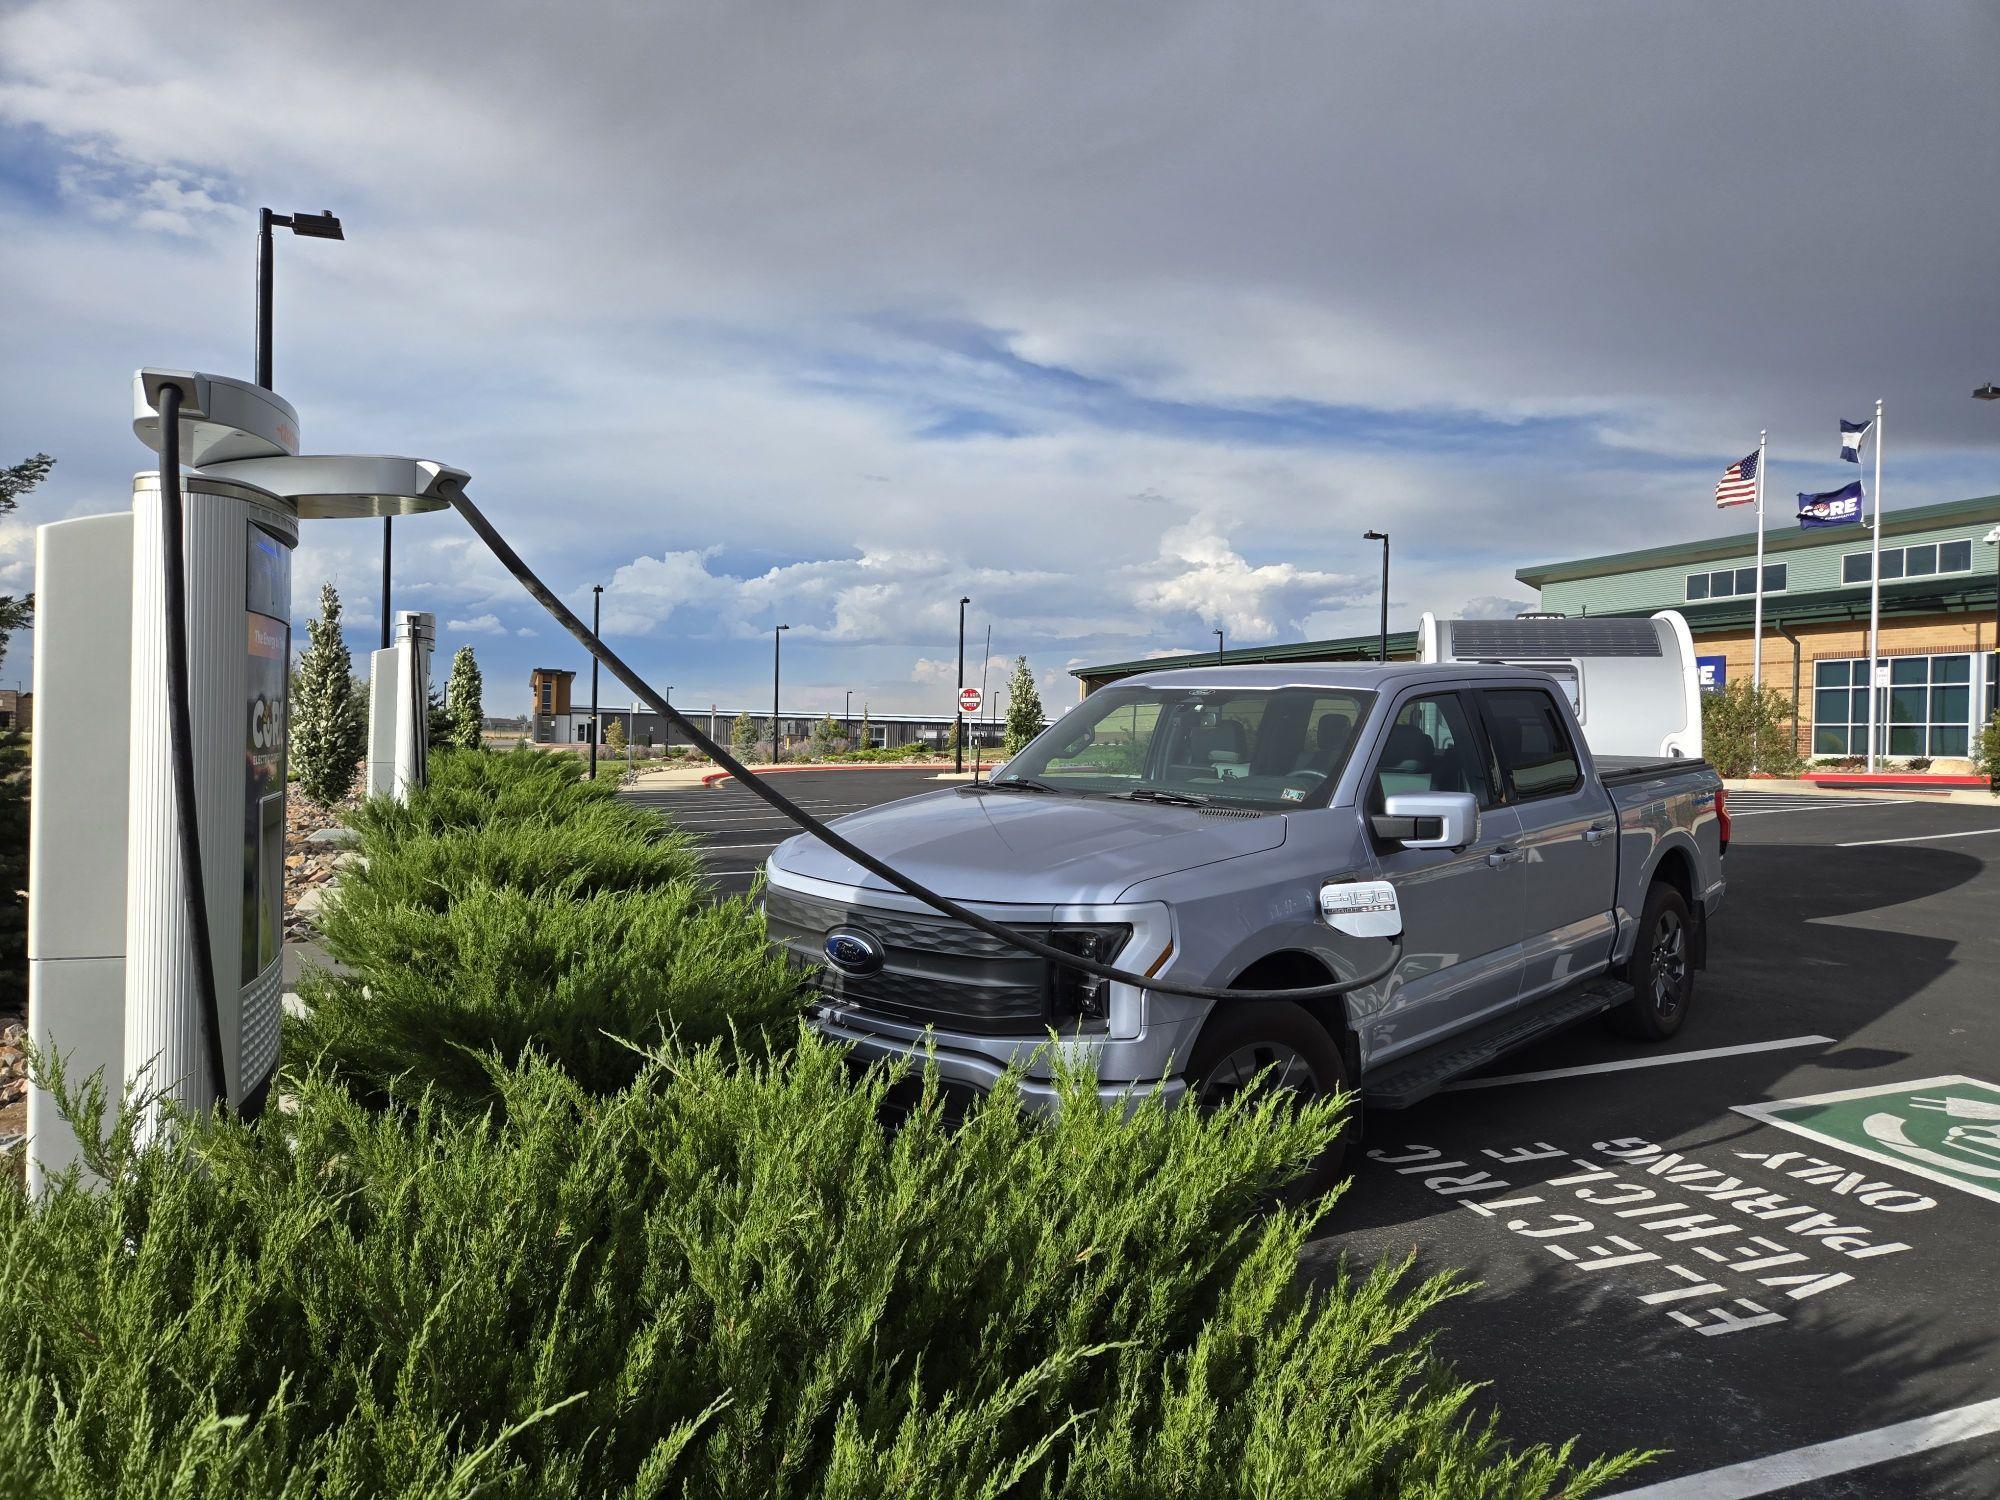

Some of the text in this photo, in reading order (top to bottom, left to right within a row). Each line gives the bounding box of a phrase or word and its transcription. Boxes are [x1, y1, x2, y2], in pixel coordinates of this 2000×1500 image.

[1801, 497, 1858, 517] CORE
[1322, 888, 1395, 907] F-150
[1480, 1142, 1856, 1301] VEHICLE
[1592, 1136, 1913, 1259] PARKING
[1733, 1150, 1938, 1213] ONLY
[1366, 1144, 1788, 1337] ELECTRIC
